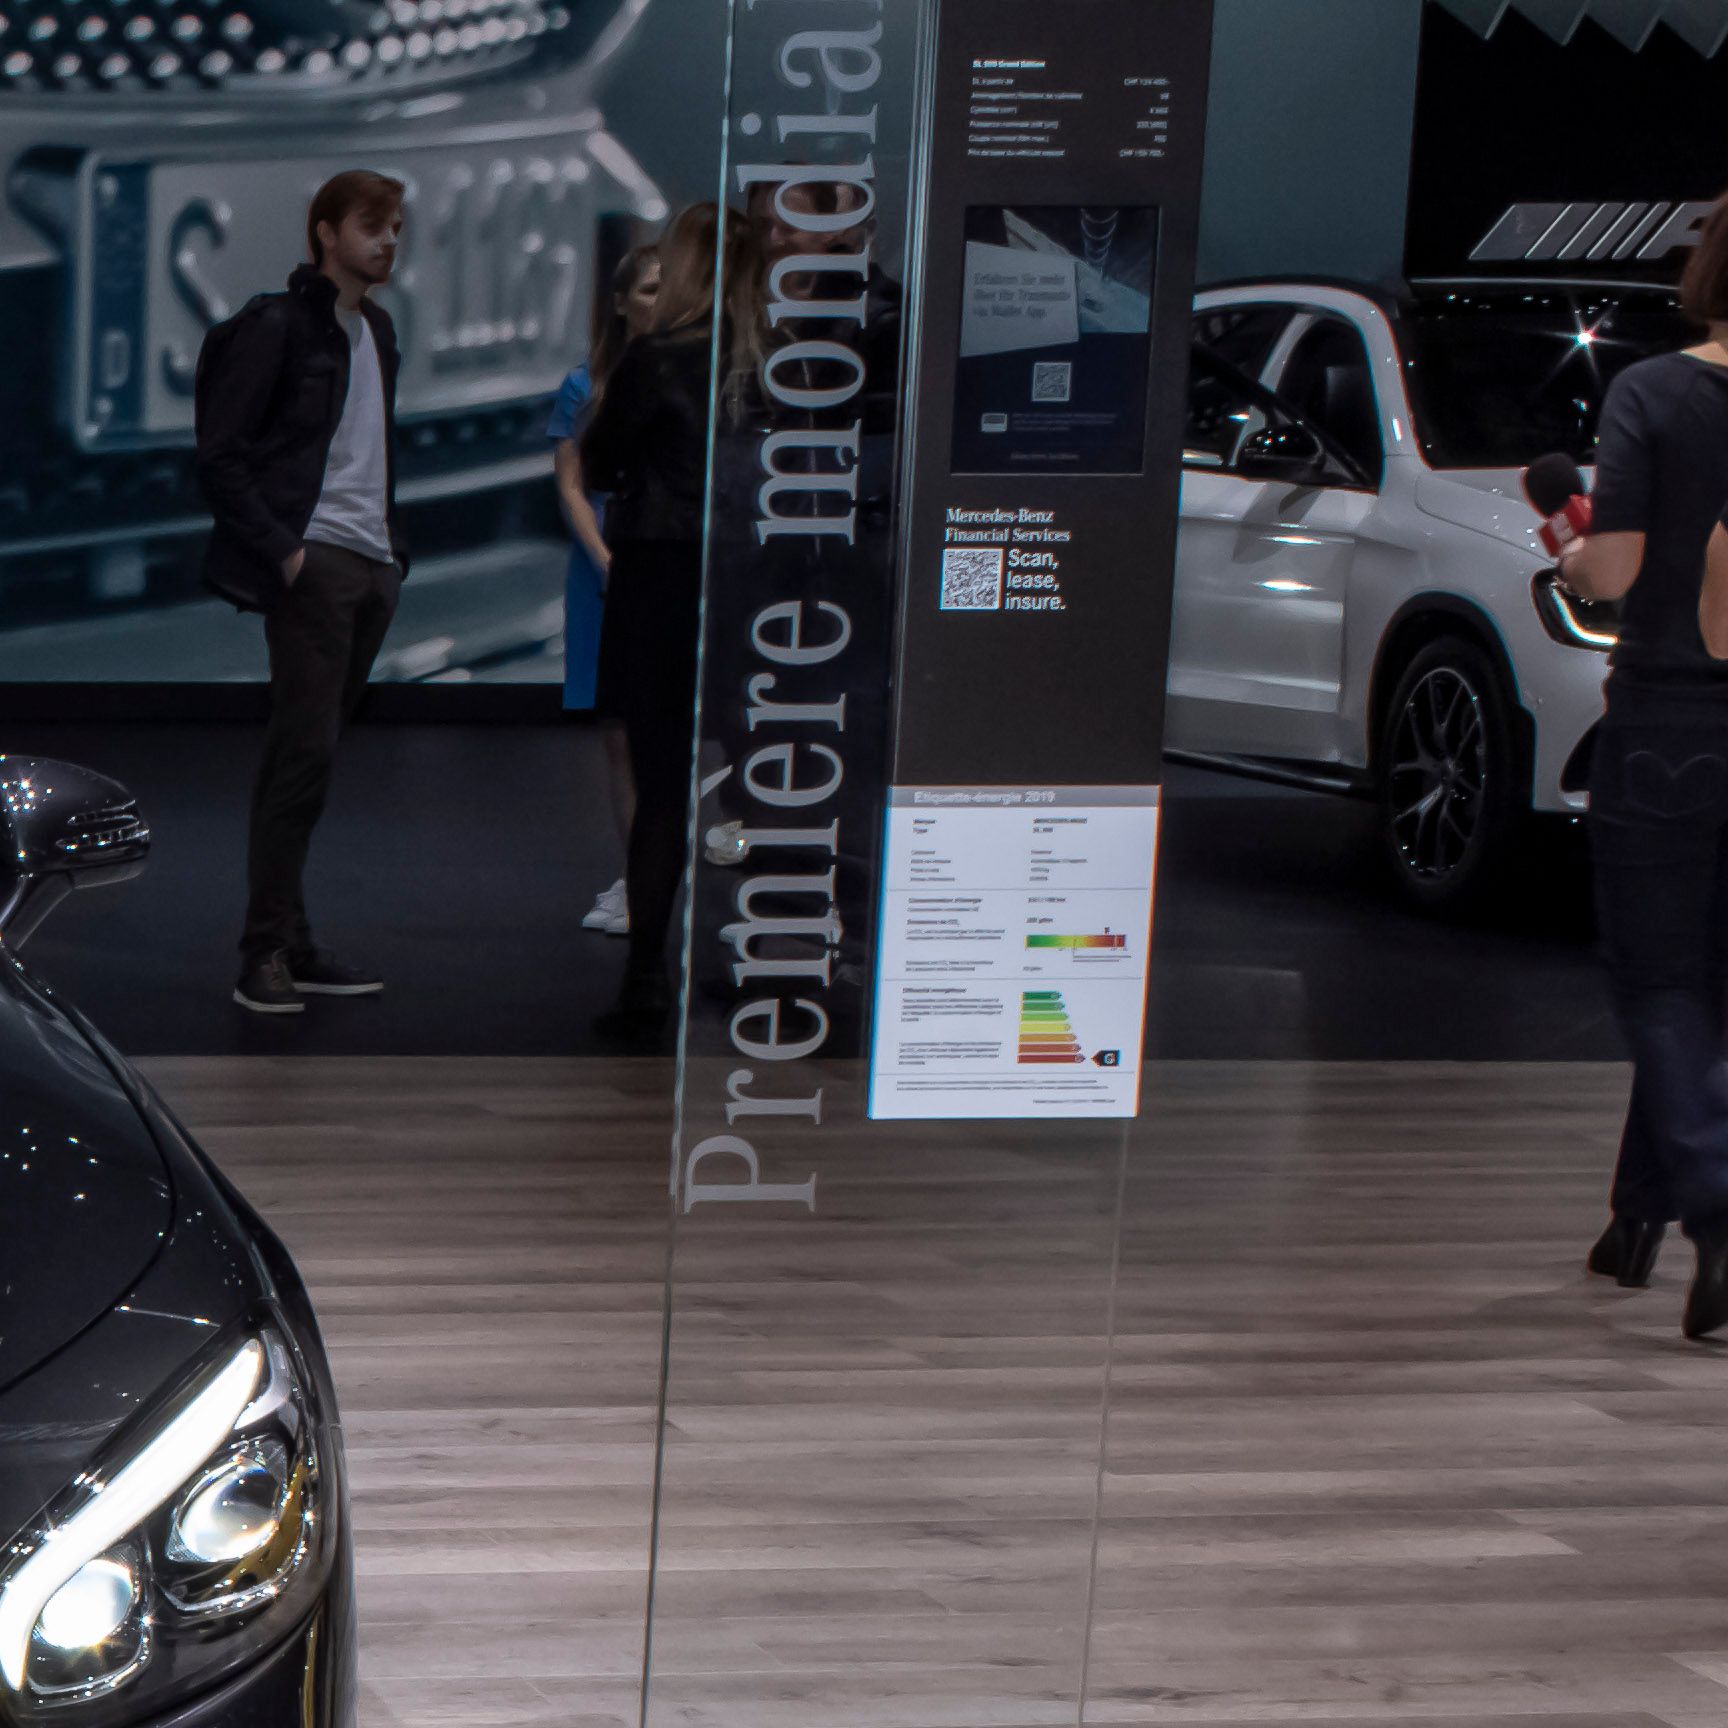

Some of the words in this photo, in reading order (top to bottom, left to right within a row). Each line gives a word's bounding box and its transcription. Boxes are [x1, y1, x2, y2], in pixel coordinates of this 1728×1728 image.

[735, 0, 884, 547] mondia
[945, 507, 1056, 523] Mercedes-Benz
[945, 527, 1009, 543] Financial
[1012, 527, 1073, 543] Services
[1007, 548, 1060, 570] Scan,
[1005, 571, 1061, 592] lease,
[1004, 592, 1067, 611] insure.
[683, 600, 853, 1214] Première
